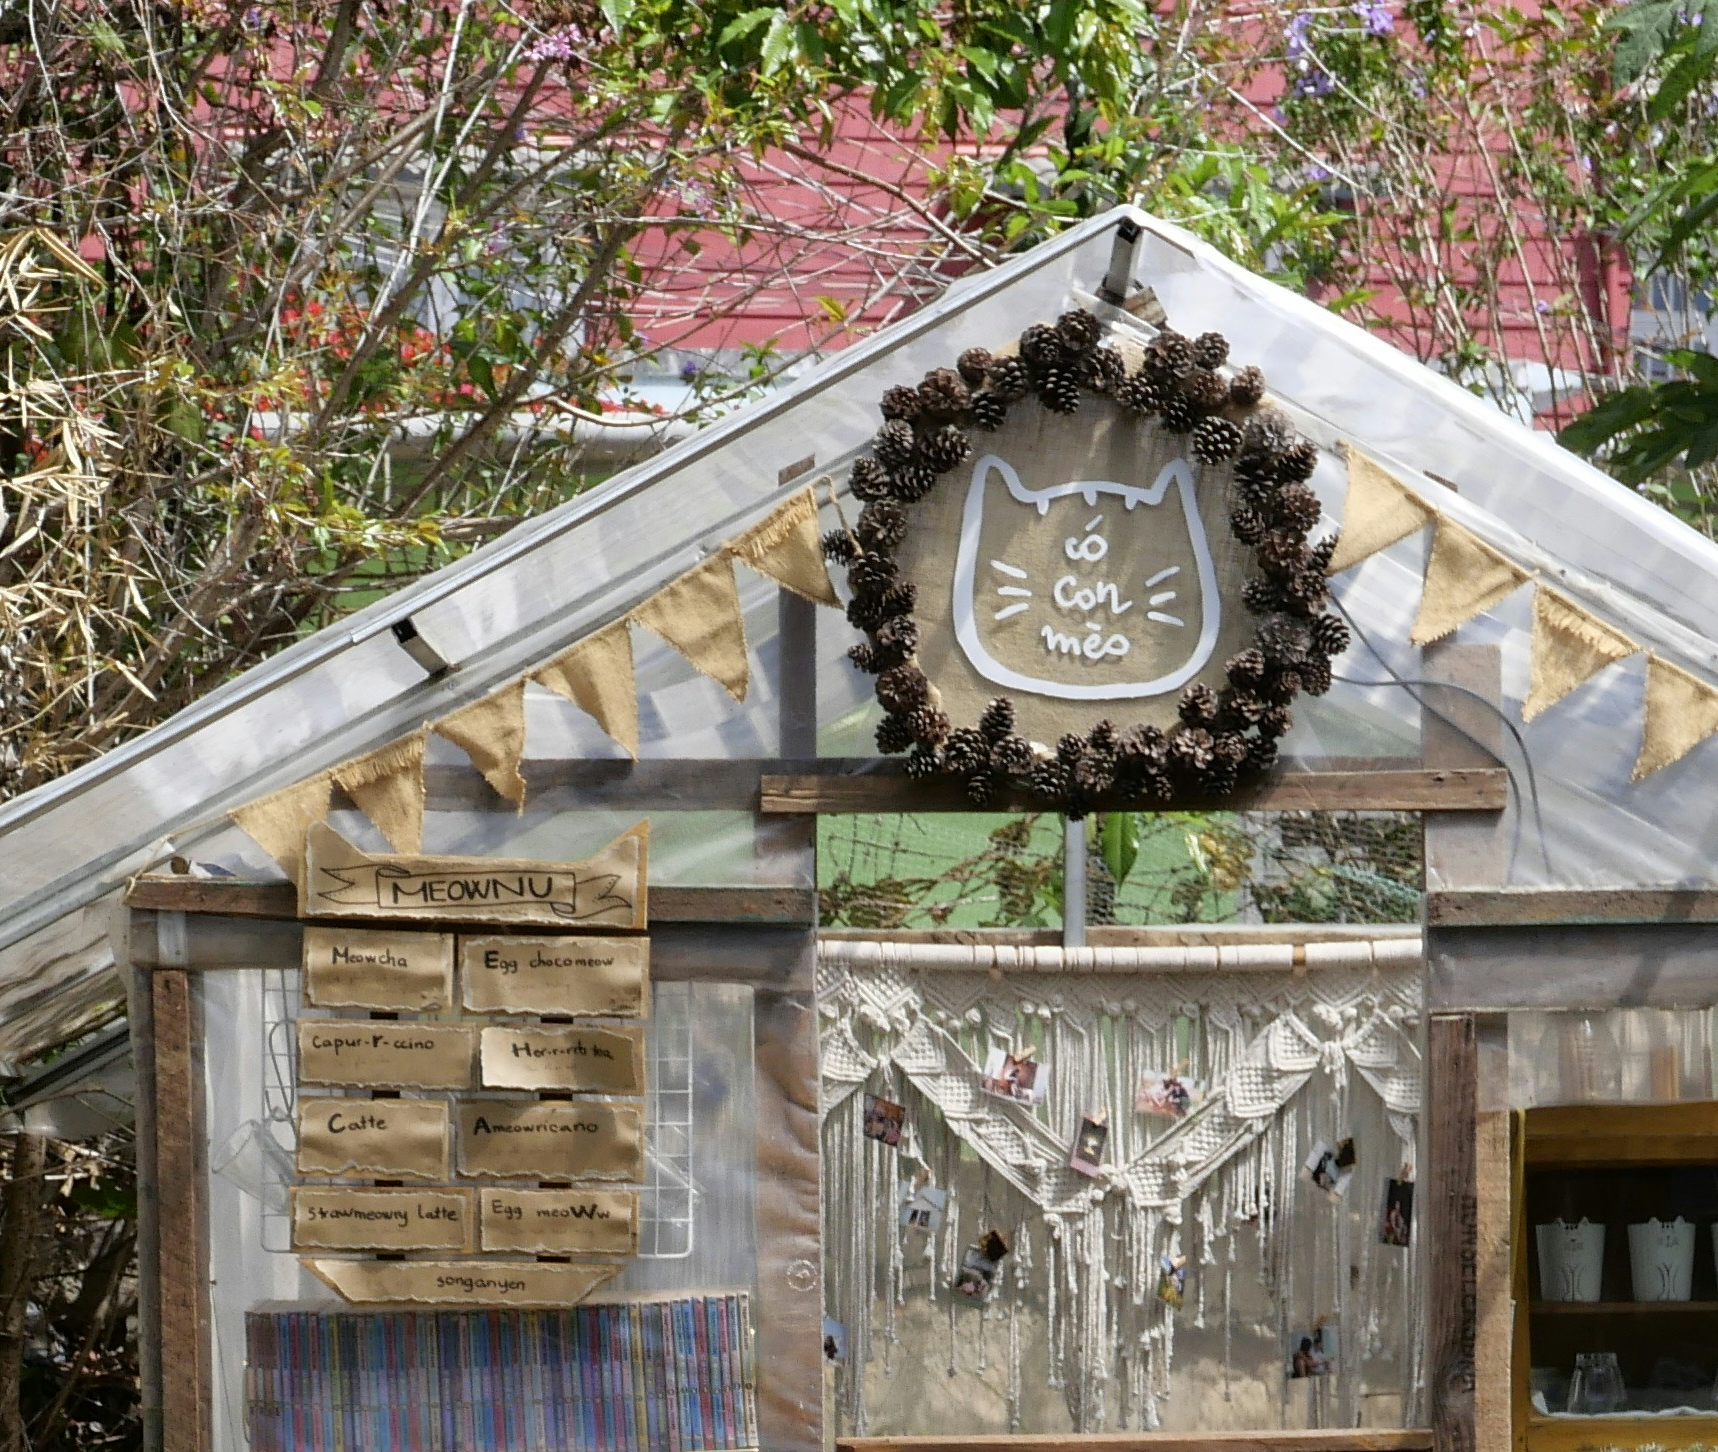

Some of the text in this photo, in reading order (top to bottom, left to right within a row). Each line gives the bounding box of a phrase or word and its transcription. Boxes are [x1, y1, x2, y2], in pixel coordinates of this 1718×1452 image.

[1040, 621, 1131, 660] mèo
[391, 875, 553, 905] MEOWNU
[332, 947, 408, 968] Meowcha
[484, 950, 518, 975] Egg
[473, 1116, 599, 1136] Ameowricano
[491, 1199, 523, 1220] Egg
